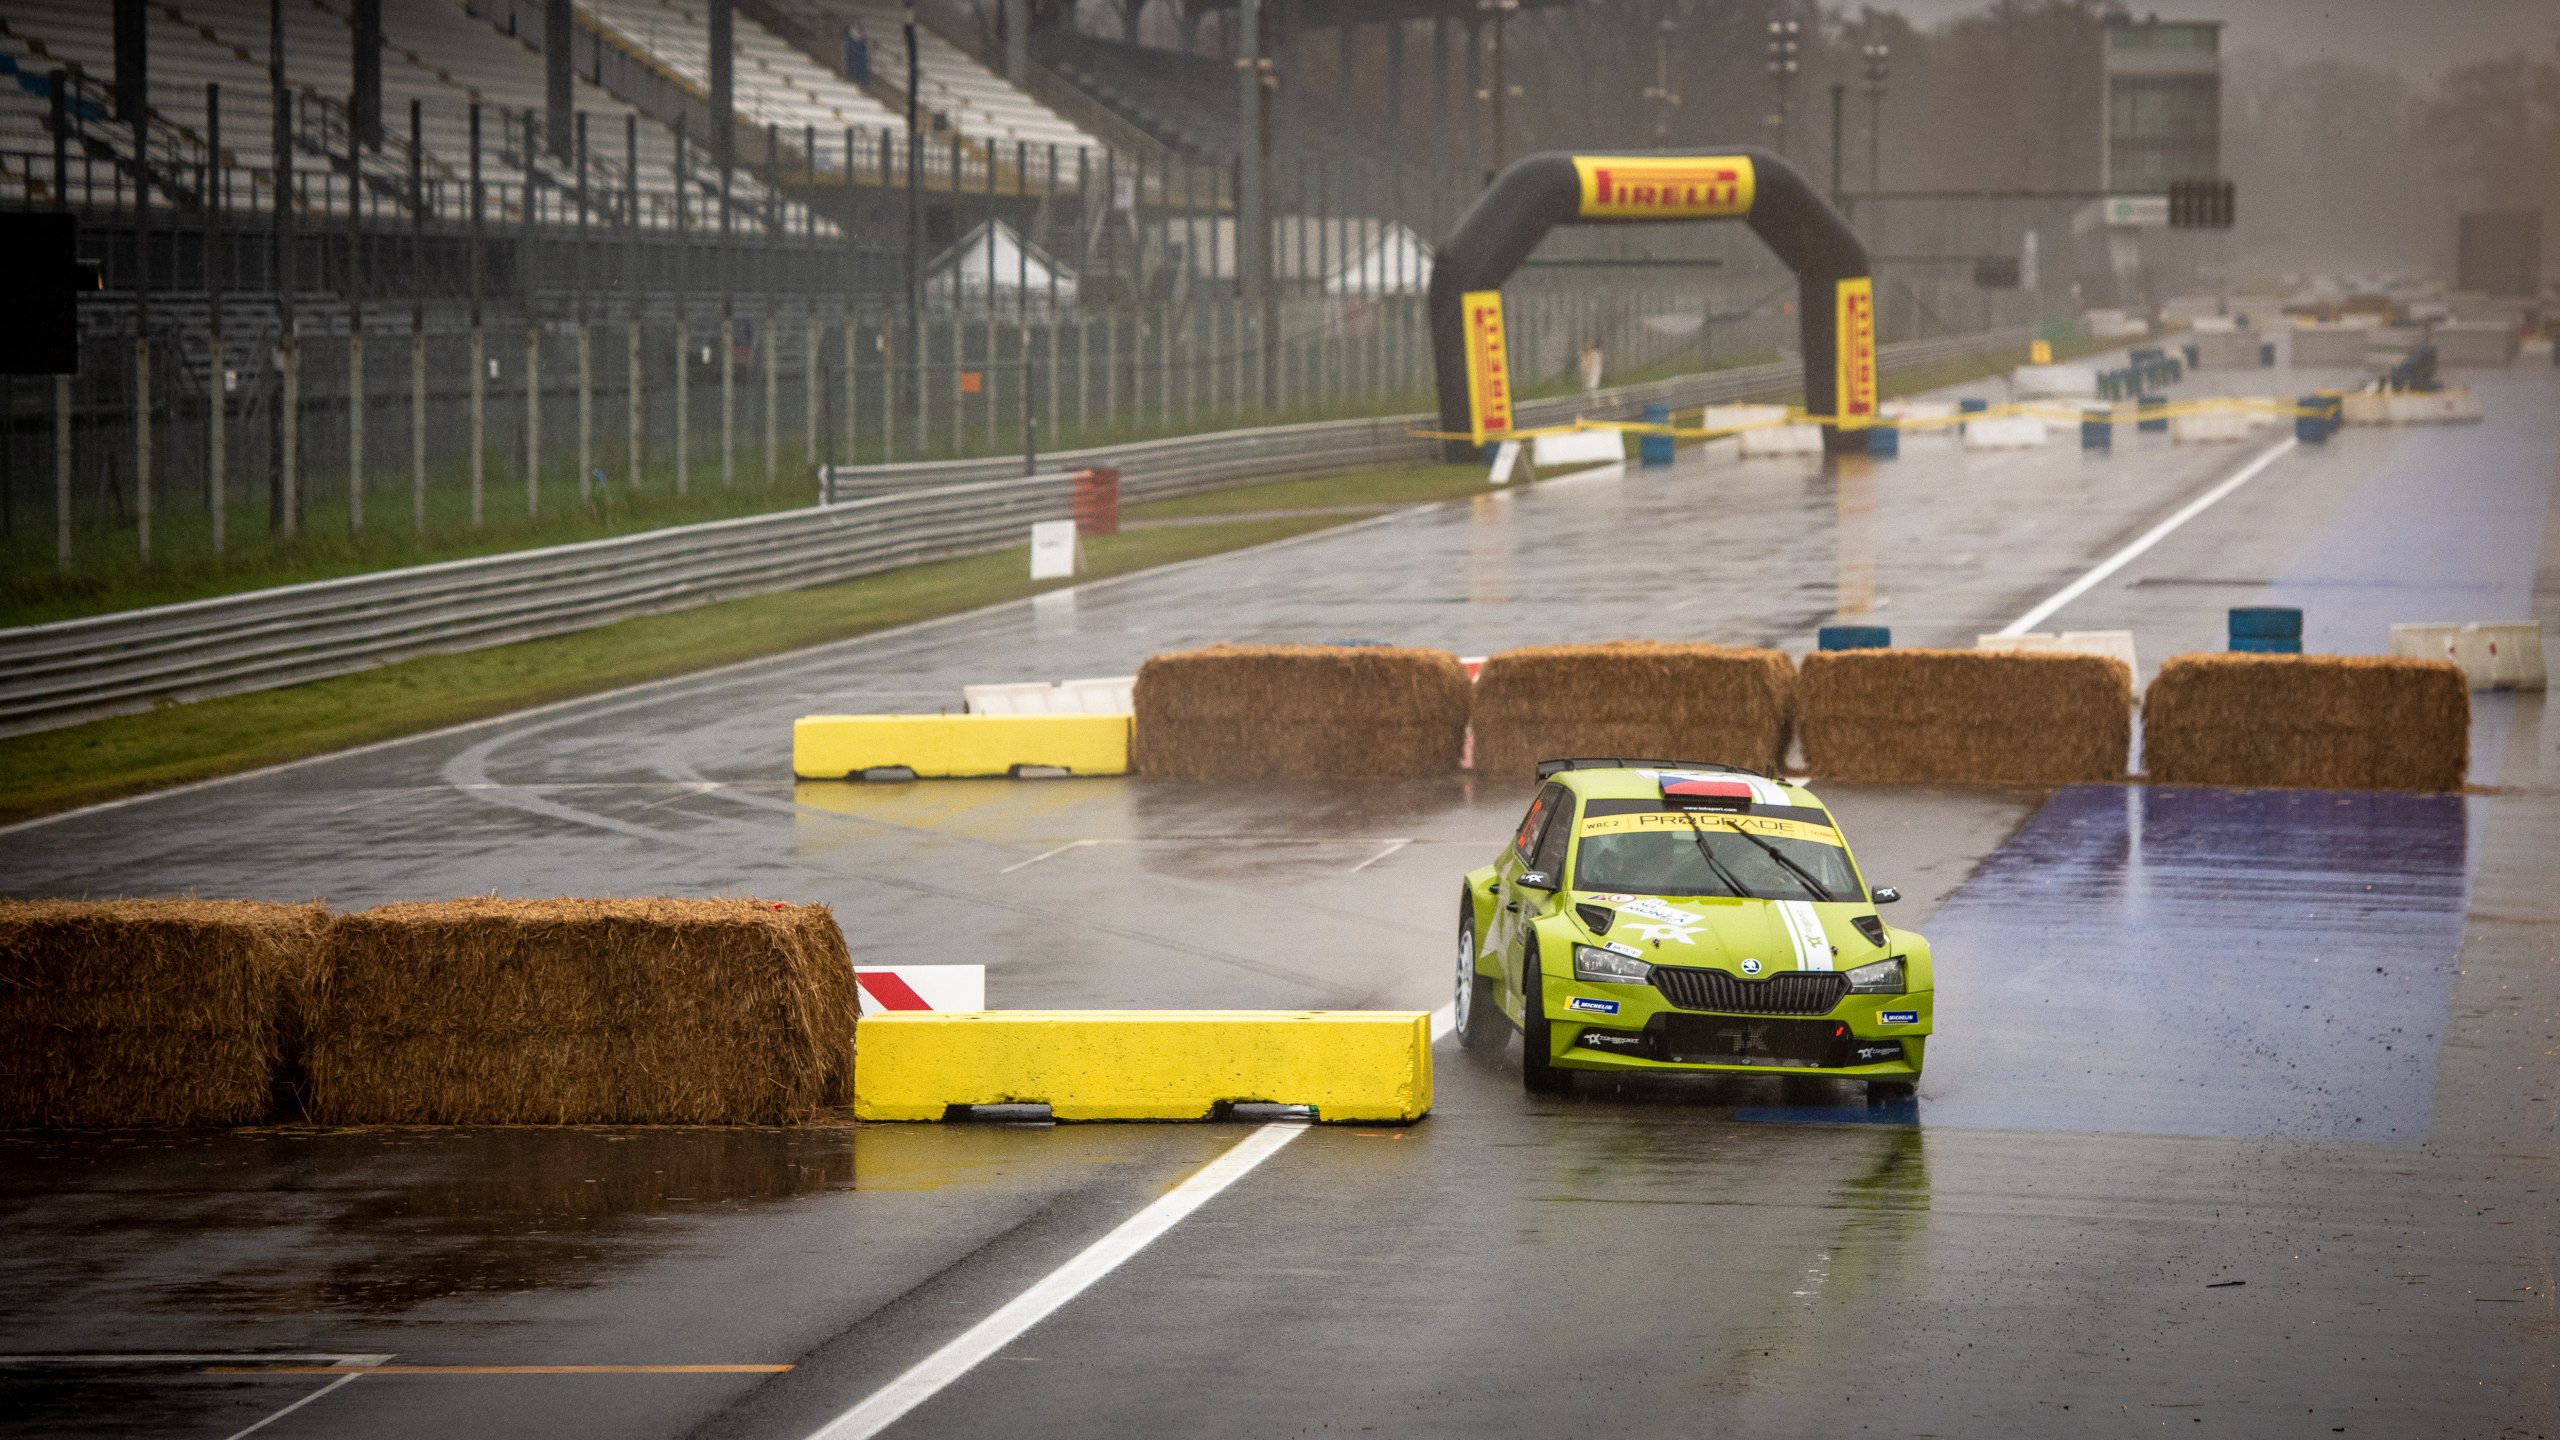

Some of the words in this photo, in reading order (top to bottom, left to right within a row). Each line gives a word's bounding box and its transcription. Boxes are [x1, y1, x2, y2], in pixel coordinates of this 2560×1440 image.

[1597, 170, 1737, 205] PIRELLI
[1475, 308, 1506, 430] PIRELLI
[1847, 294, 1871, 415] PIRELLI
[1586, 822, 1609, 830] WRC
